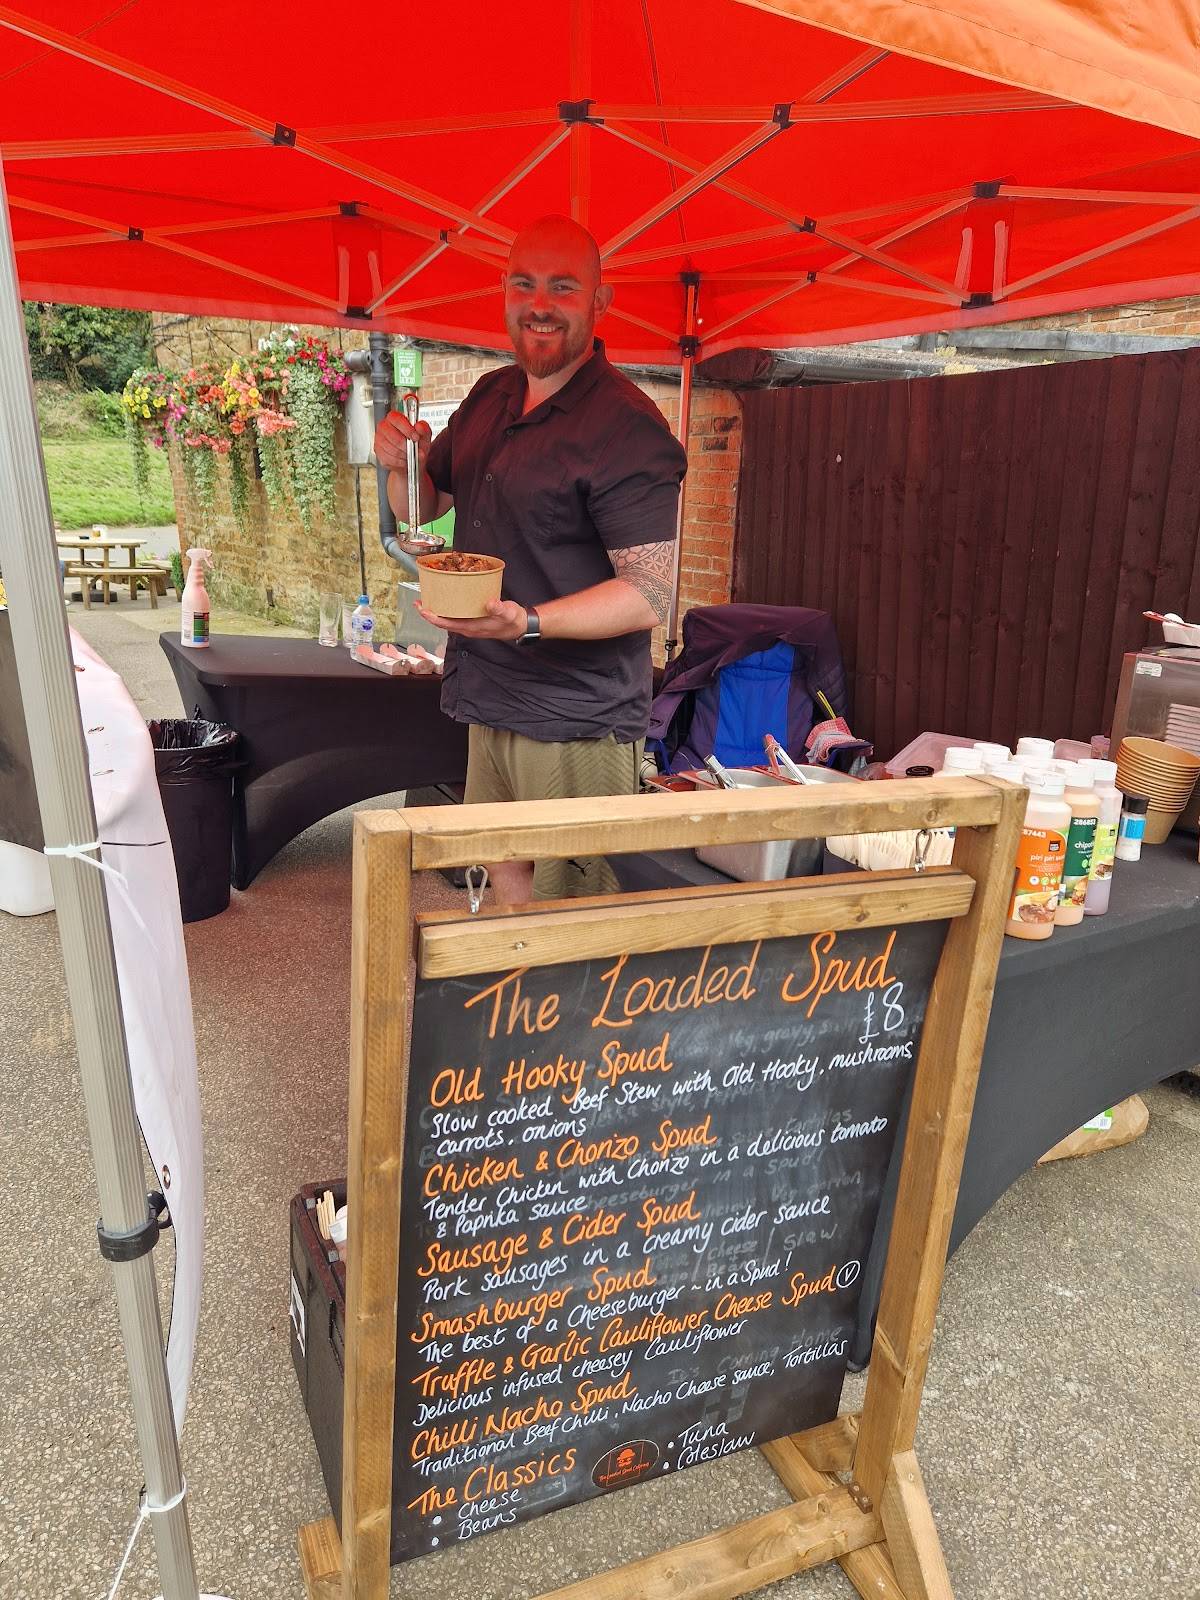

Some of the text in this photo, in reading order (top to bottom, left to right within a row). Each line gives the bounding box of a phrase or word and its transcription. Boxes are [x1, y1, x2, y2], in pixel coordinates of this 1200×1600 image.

[1074, 841, 1095, 851] chipot
[464, 930, 897, 1039] The Loaded Spud
[858, 981, 905, 1044] £8
[430, 1066, 484, 1108] Old
[501, 1054, 586, 1104] Hooky
[597, 1032, 674, 1086] Spud
[431, 1112, 477, 1139] Slow
[487, 1098, 553, 1128] cooked
[569, 1087, 609, 1113] Beef
[614, 1081, 661, 1106] Stew
[672, 1070, 718, 1097] with
[722, 1062, 754, 1088] Old
[422, 1193, 487, 1222] Tender
[496, 1179, 569, 1208] Chicken
[578, 1165, 624, 1189] with
[699, 1146, 723, 1167] in
[727, 1148, 740, 1162] a
[747, 1129, 823, 1158] delicious
[830, 1115, 888, 1144] tomato
[424, 1156, 525, 1197] Chicken
[535, 1150, 549, 1173] &
[652, 1114, 717, 1158] Spud
[522, 1117, 587, 1143] onions
[416, 1233, 530, 1277] Sausage
[538, 1226, 554, 1250] &
[562, 1209, 628, 1246] Cider
[636, 1190, 702, 1237] Spud
[422, 1275, 471, 1303] Pork
[480, 1254, 569, 1291] sausages
[582, 1242, 609, 1266] in
[616, 1241, 632, 1259] a
[643, 1221, 714, 1254] creamy
[720, 1206, 769, 1236] cider
[773, 1195, 831, 1226] sauce
[436, 1222, 447, 1239] &
[528, 1195, 588, 1221] sauce
[410, 1285, 574, 1343] Smashburger
[587, 1258, 658, 1304] Spud
[411, 1357, 497, 1398] Truffle
[503, 1356, 514, 1374] &
[520, 1330, 592, 1369] Garlic
[599, 1309, 709, 1353] Cauliflower
[714, 1290, 773, 1321] Cheese
[781, 1265, 837, 1307] Spud
[417, 1340, 454, 1364] The
[462, 1327, 508, 1353] best
[516, 1316, 536, 1344] of
[545, 1318, 558, 1333] a
[567, 1284, 687, 1330] Cheeseburger
[705, 1272, 724, 1292] in
[727, 1271, 739, 1285] a
[411, 1437, 516, 1477] Traditional
[523, 1418, 559, 1446] Beef
[622, 1391, 672, 1414] Nacho
[675, 1373, 727, 1400] Cheese
[732, 1360, 775, 1386] sauce,
[782, 1339, 848, 1370] Tortillas
[412, 1319, 749, 1427] Delicious infused cheesey Cauliflower
[410, 1371, 638, 1461] Chilli Nacho Spud
[677, 1431, 756, 1471] Coleslaw
[678, 1421, 729, 1448] Tuna
[408, 1448, 578, 1516] The Classics
[458, 1488, 522, 1520] Cheese
[458, 1508, 517, 1540] Beans
